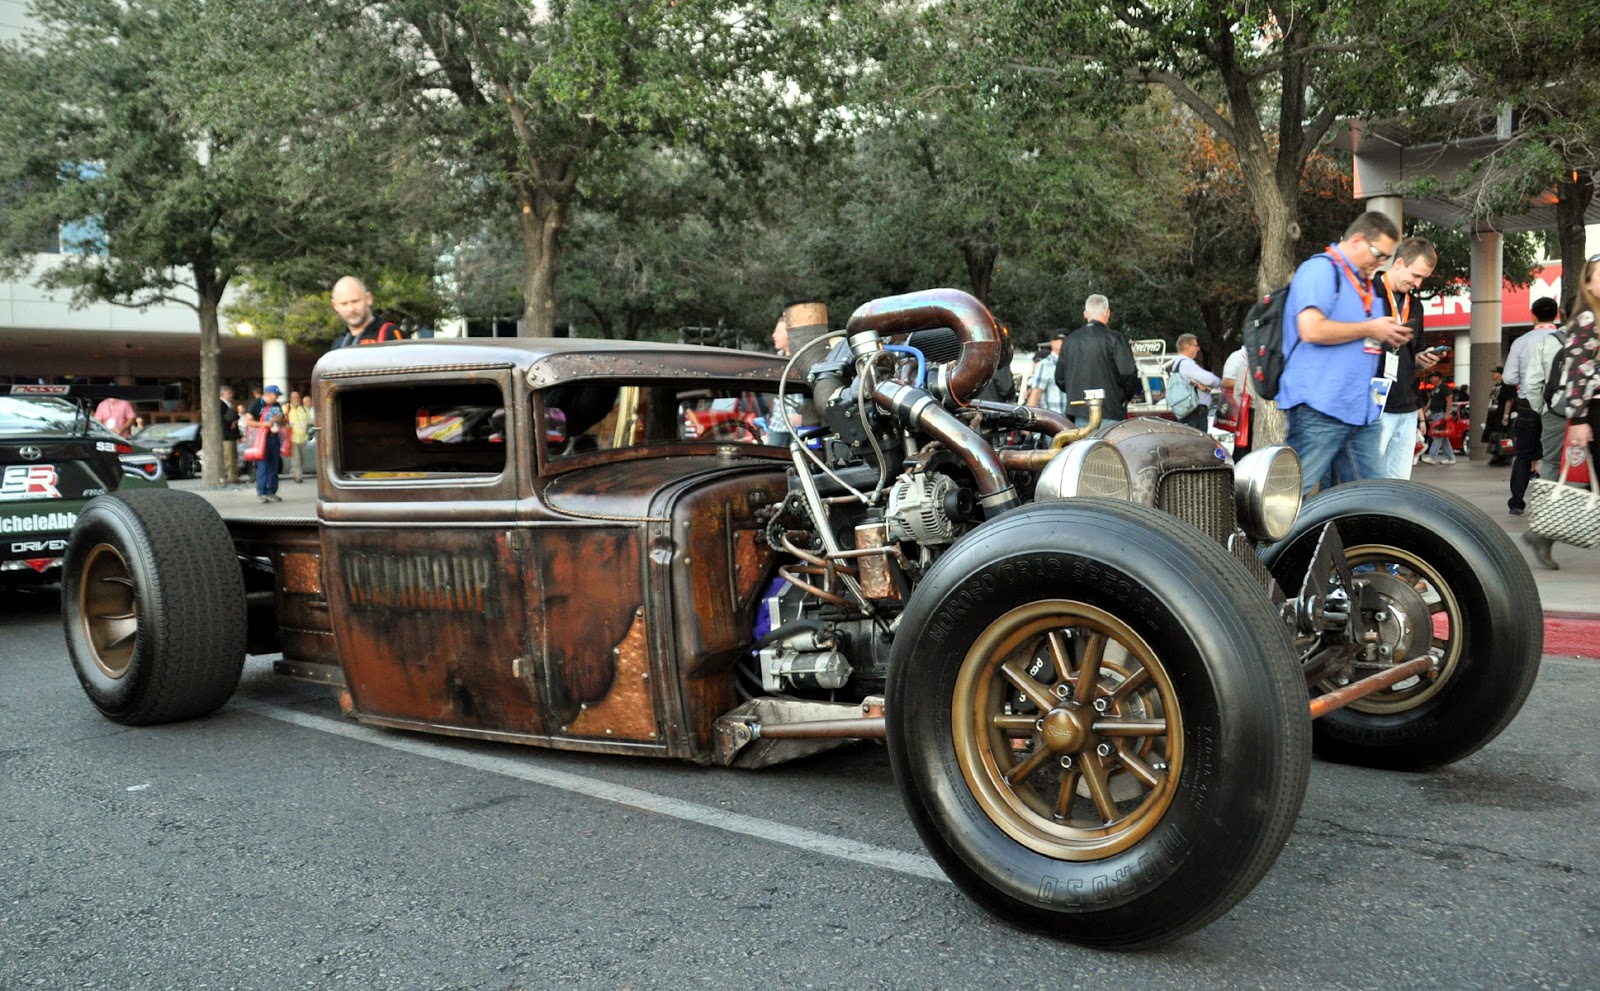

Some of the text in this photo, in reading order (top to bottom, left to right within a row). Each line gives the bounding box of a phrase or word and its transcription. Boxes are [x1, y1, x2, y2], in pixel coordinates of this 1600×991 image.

[928, 557, 1162, 645] MOROSO DRAG SPECIAL
